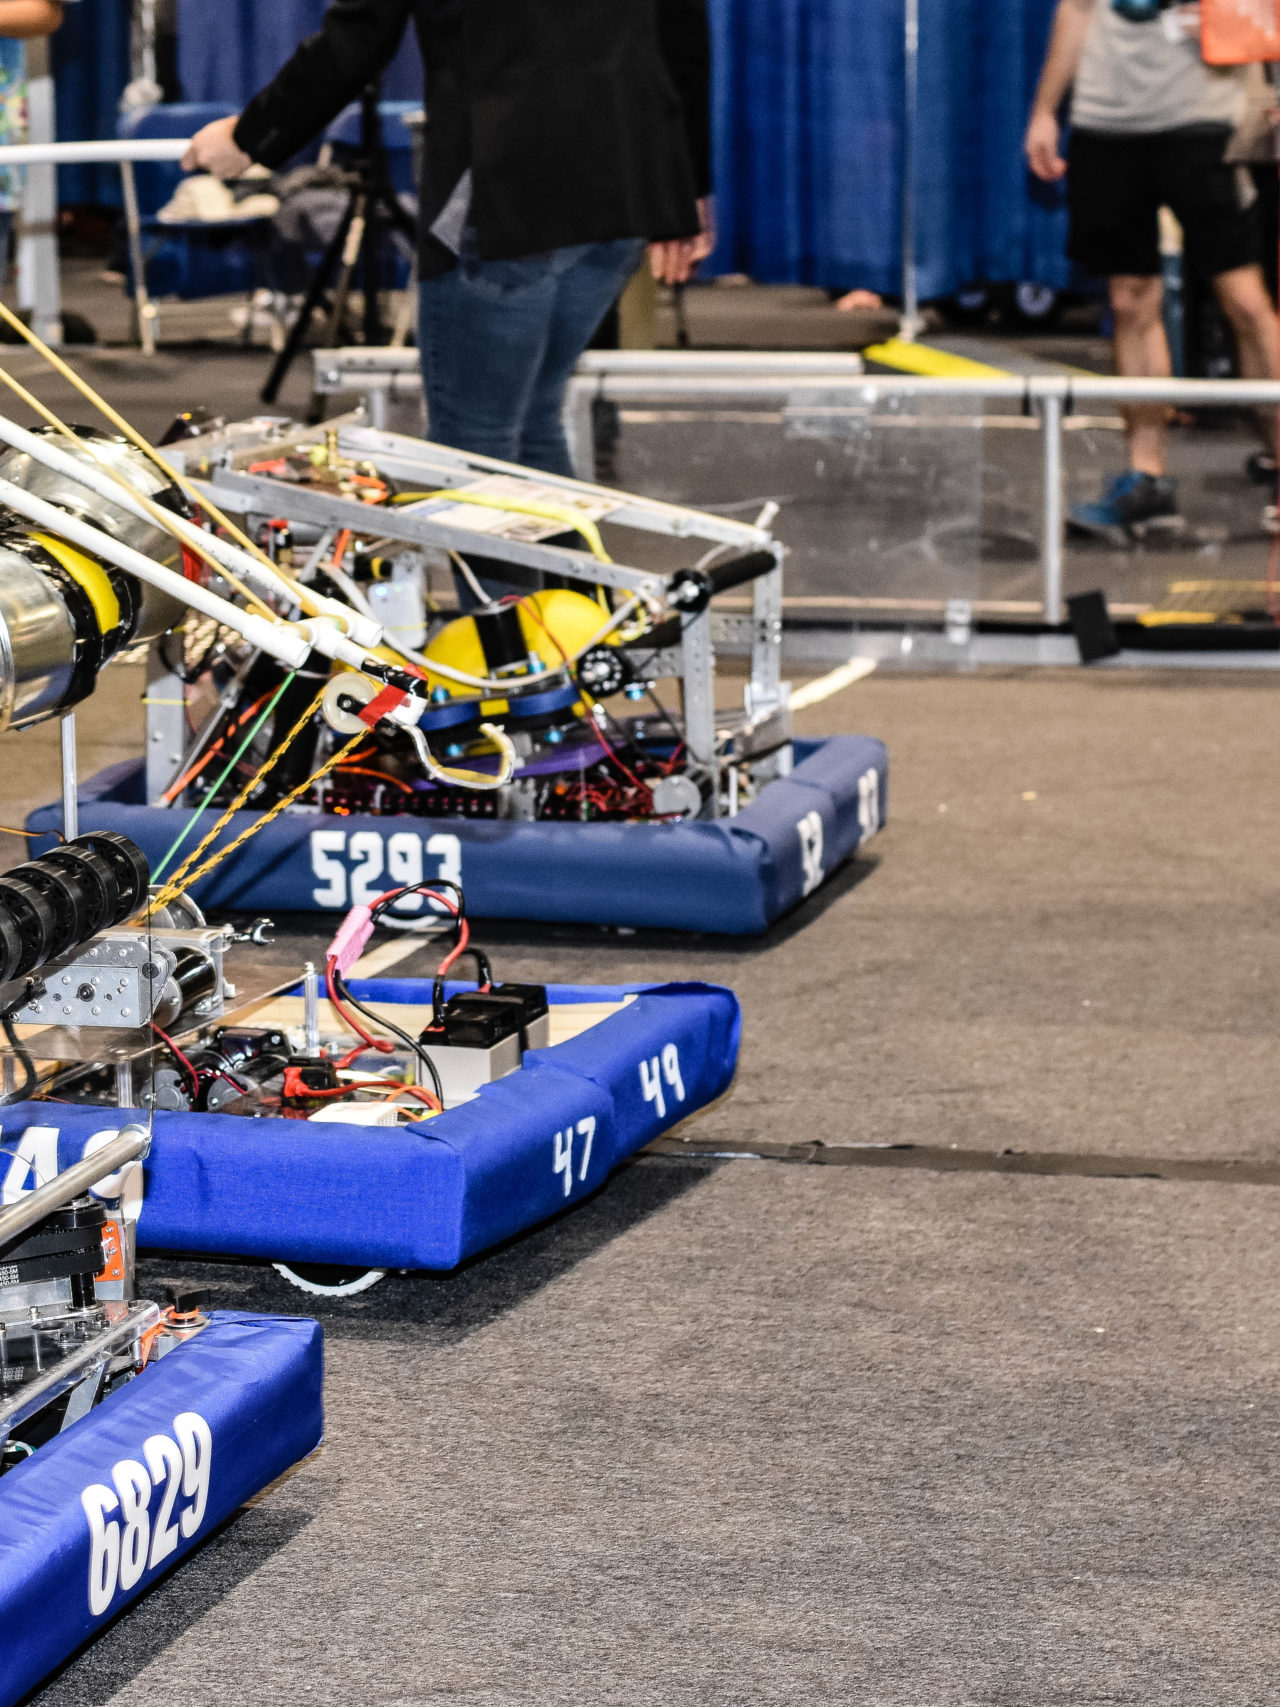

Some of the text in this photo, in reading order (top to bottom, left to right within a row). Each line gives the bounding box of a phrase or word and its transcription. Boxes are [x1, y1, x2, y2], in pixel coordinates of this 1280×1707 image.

[310, 830, 463, 913] 5293
[552, 1043, 686, 1197] 47 49
[81, 1411, 213, 1616] 6829
